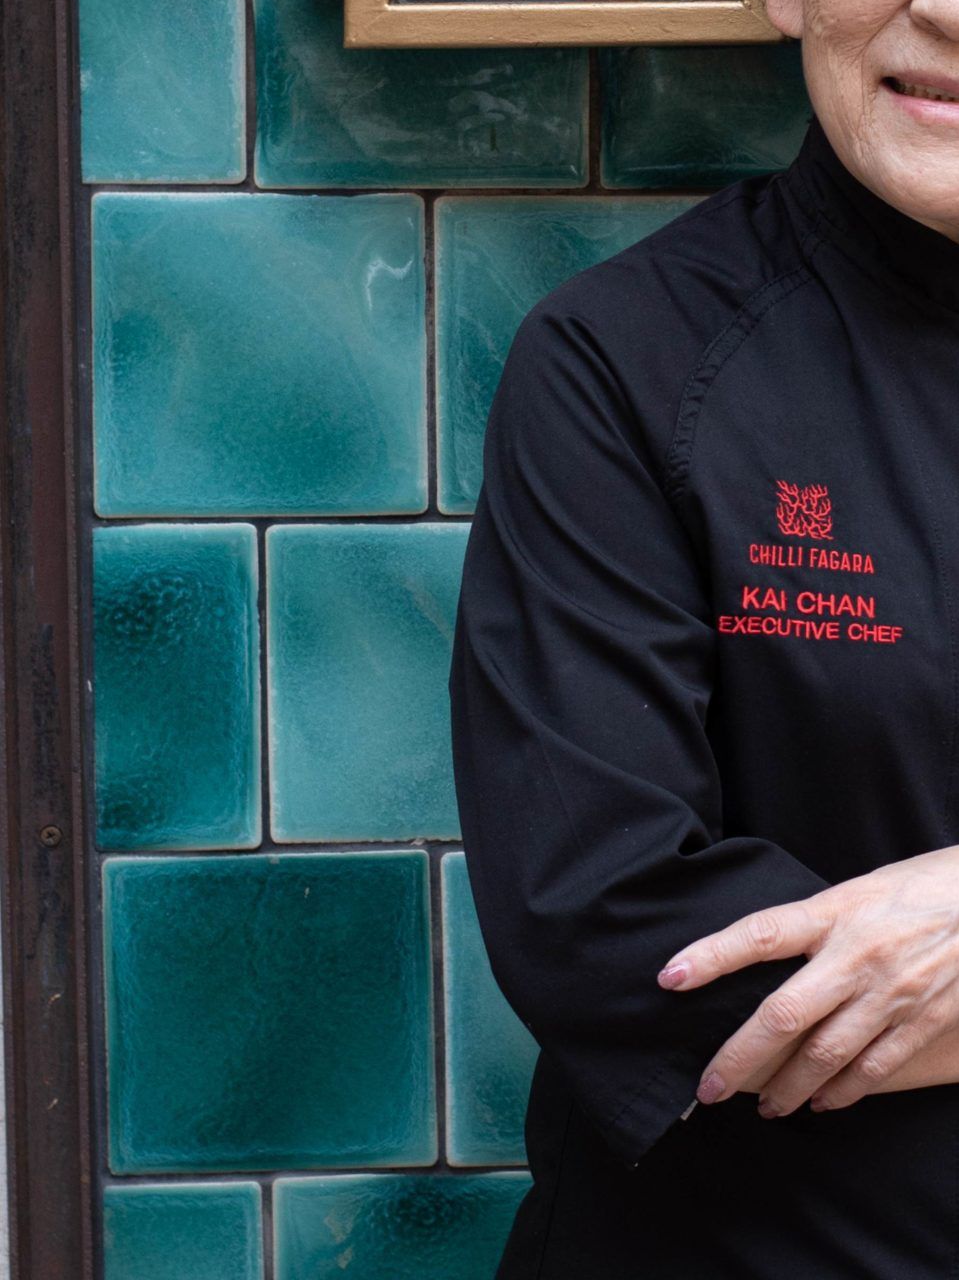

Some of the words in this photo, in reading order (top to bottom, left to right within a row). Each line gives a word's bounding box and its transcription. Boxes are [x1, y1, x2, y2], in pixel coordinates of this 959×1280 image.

[749, 544, 803, 568] CHILLI
[808, 548, 875, 574] FAGARA
[741, 586, 788, 611] KAI
[796, 591, 876, 619] CHAN
[718, 615, 841, 641] EXECUTIVE
[847, 622, 903, 644] CHEF
